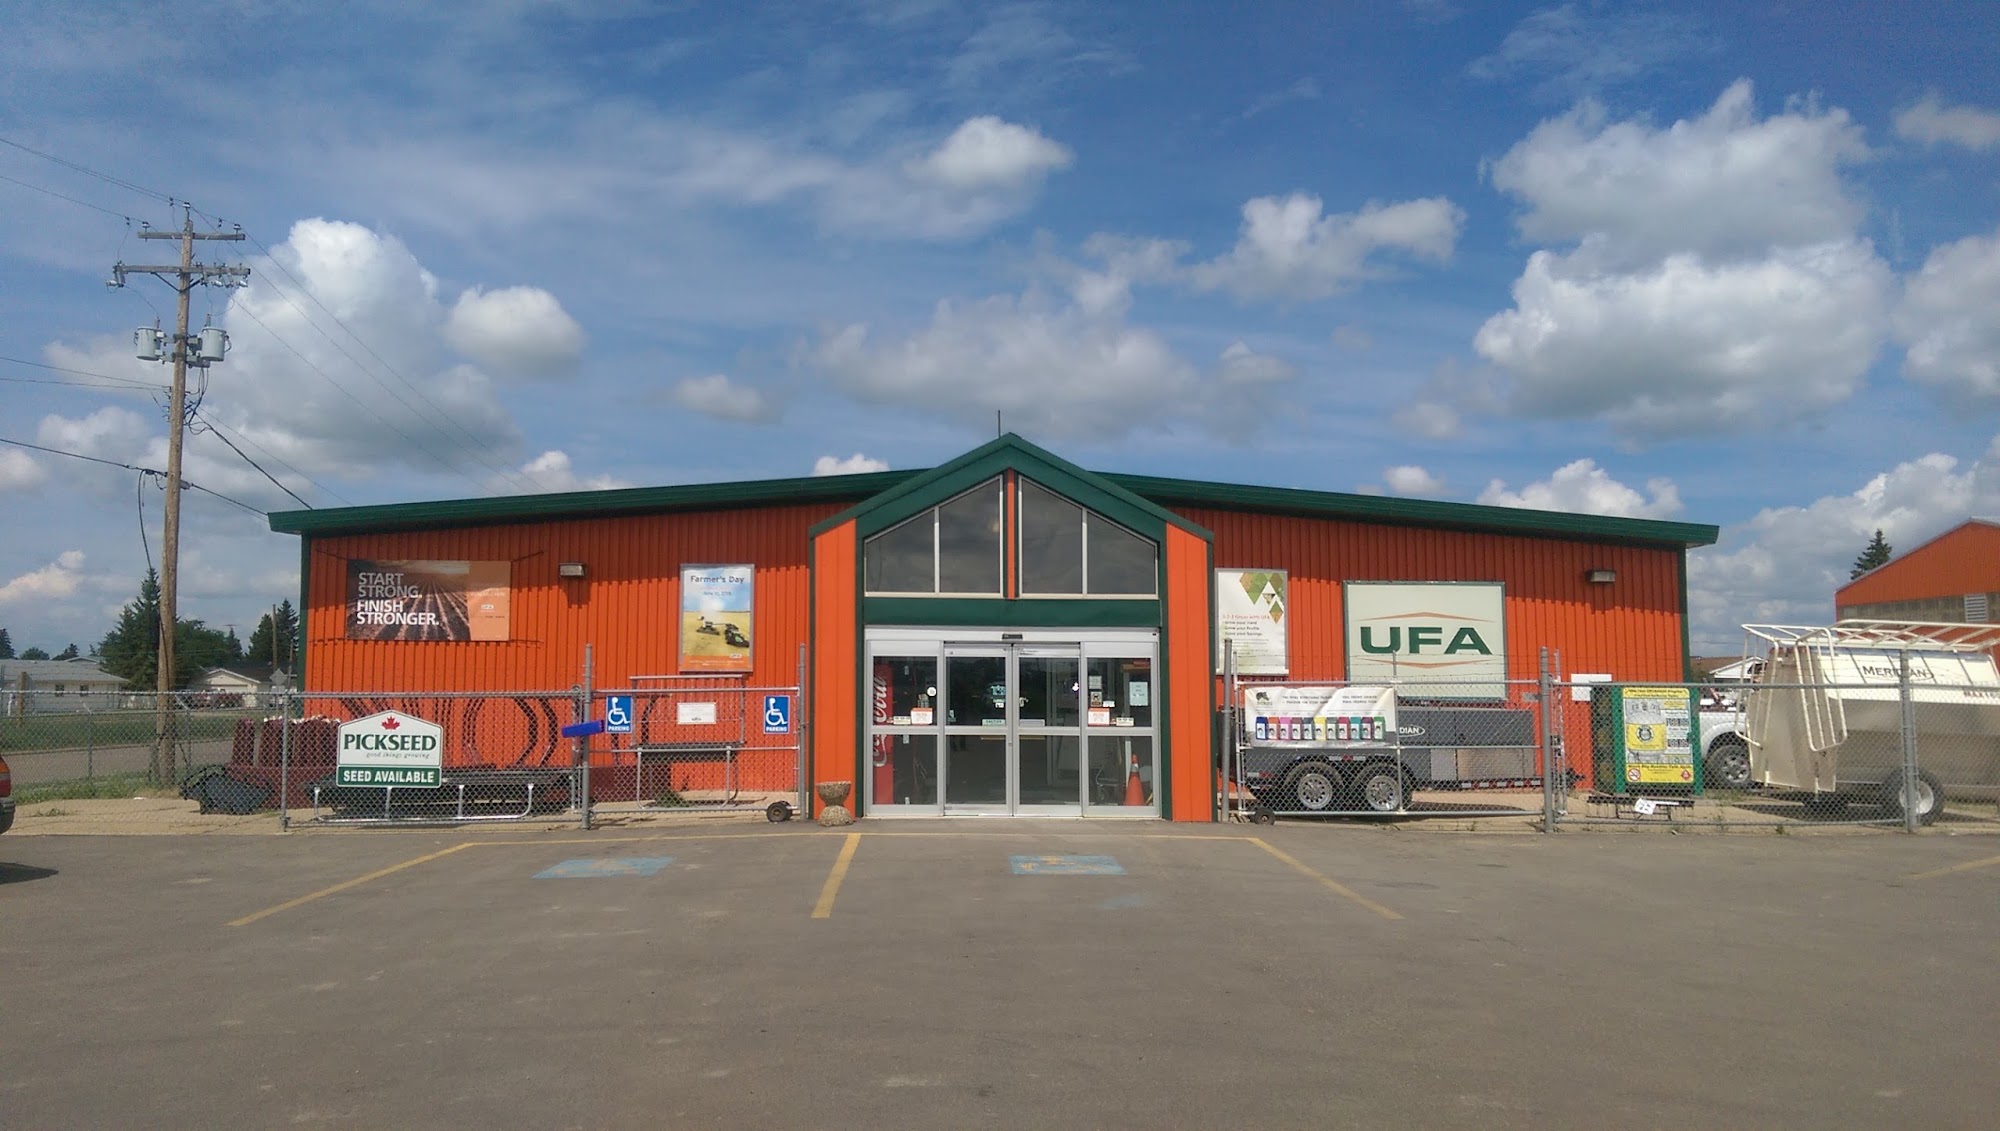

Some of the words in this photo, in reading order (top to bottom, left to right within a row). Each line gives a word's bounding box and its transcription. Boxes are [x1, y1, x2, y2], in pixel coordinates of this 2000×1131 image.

[358, 572, 405, 586] START
[690, 575, 727, 584] Farmer's
[728, 575, 746, 585] Day
[358, 585, 423, 599] STRONG.
[357, 600, 404, 613] FINISH
[356, 612, 440, 626] STRONGER.
[1360, 626, 1493, 655] UFA
[1862, 665, 1927, 678] MERIDAN
[1399, 726, 1419, 734] DIAN
[343, 734, 437, 751] PICKSEED
[343, 770, 372, 782] SEED
[374, 770, 435, 783] AVAILABLE
